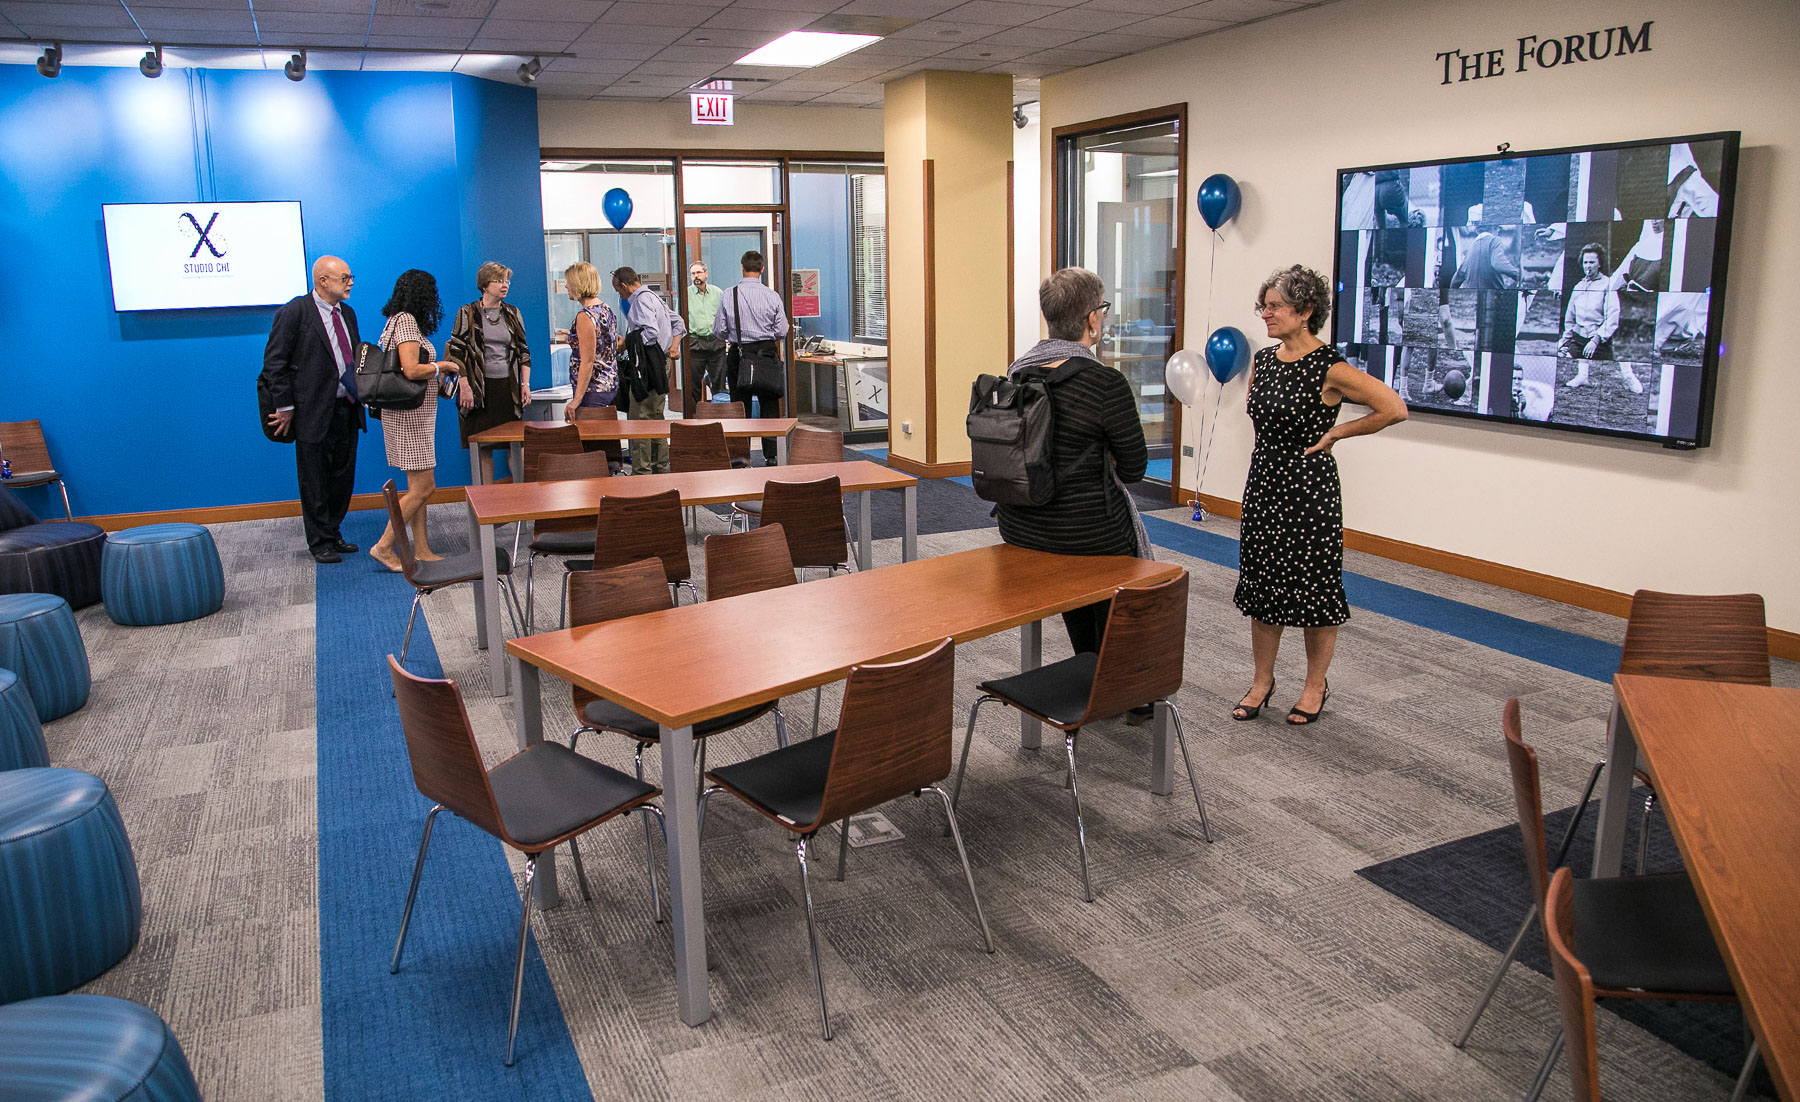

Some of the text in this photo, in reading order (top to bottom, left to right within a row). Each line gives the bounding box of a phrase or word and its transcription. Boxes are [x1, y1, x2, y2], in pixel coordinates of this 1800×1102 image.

[1435, 21, 1655, 85] THE FORUM
[696, 96, 728, 117] EXIT
[183, 262, 230, 273] STUDIO CHI
